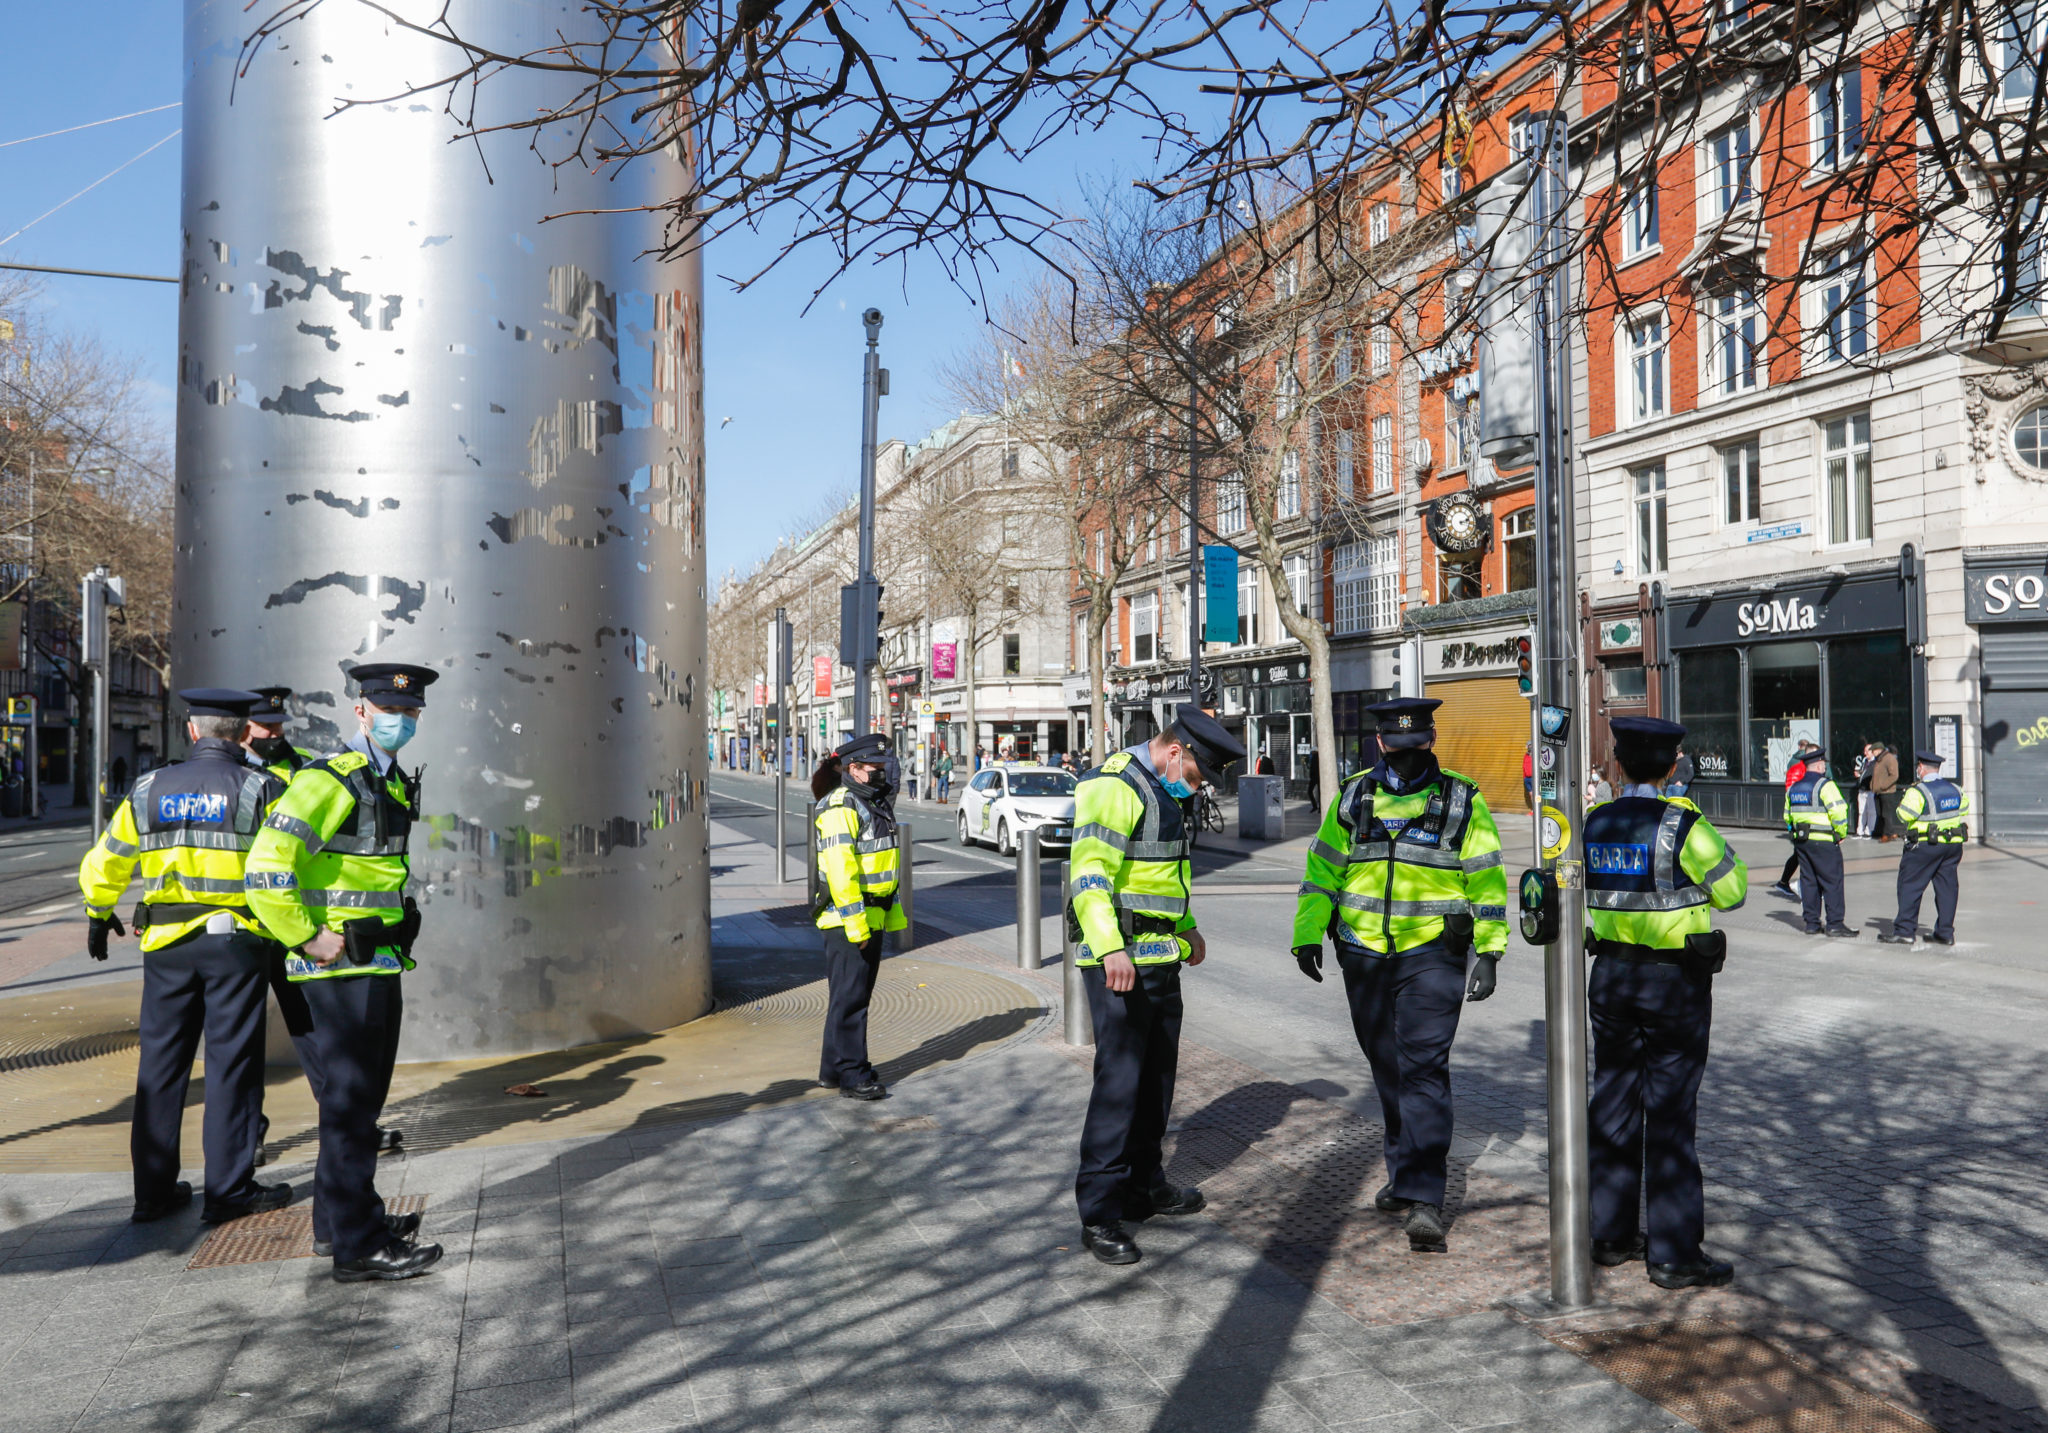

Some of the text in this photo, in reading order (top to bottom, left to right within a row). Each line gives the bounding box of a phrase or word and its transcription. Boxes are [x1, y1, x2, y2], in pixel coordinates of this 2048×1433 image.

[1738, 597, 1818, 637] SoMa
[1700, 756, 1727, 770] SoMa
[1541, 771, 1555, 781] AN
[162, 796, 221, 818] GARDA
[1590, 847, 1645, 871] GARDA
[273, 874, 298, 887] GA
[1480, 906, 1506, 918] GAR
